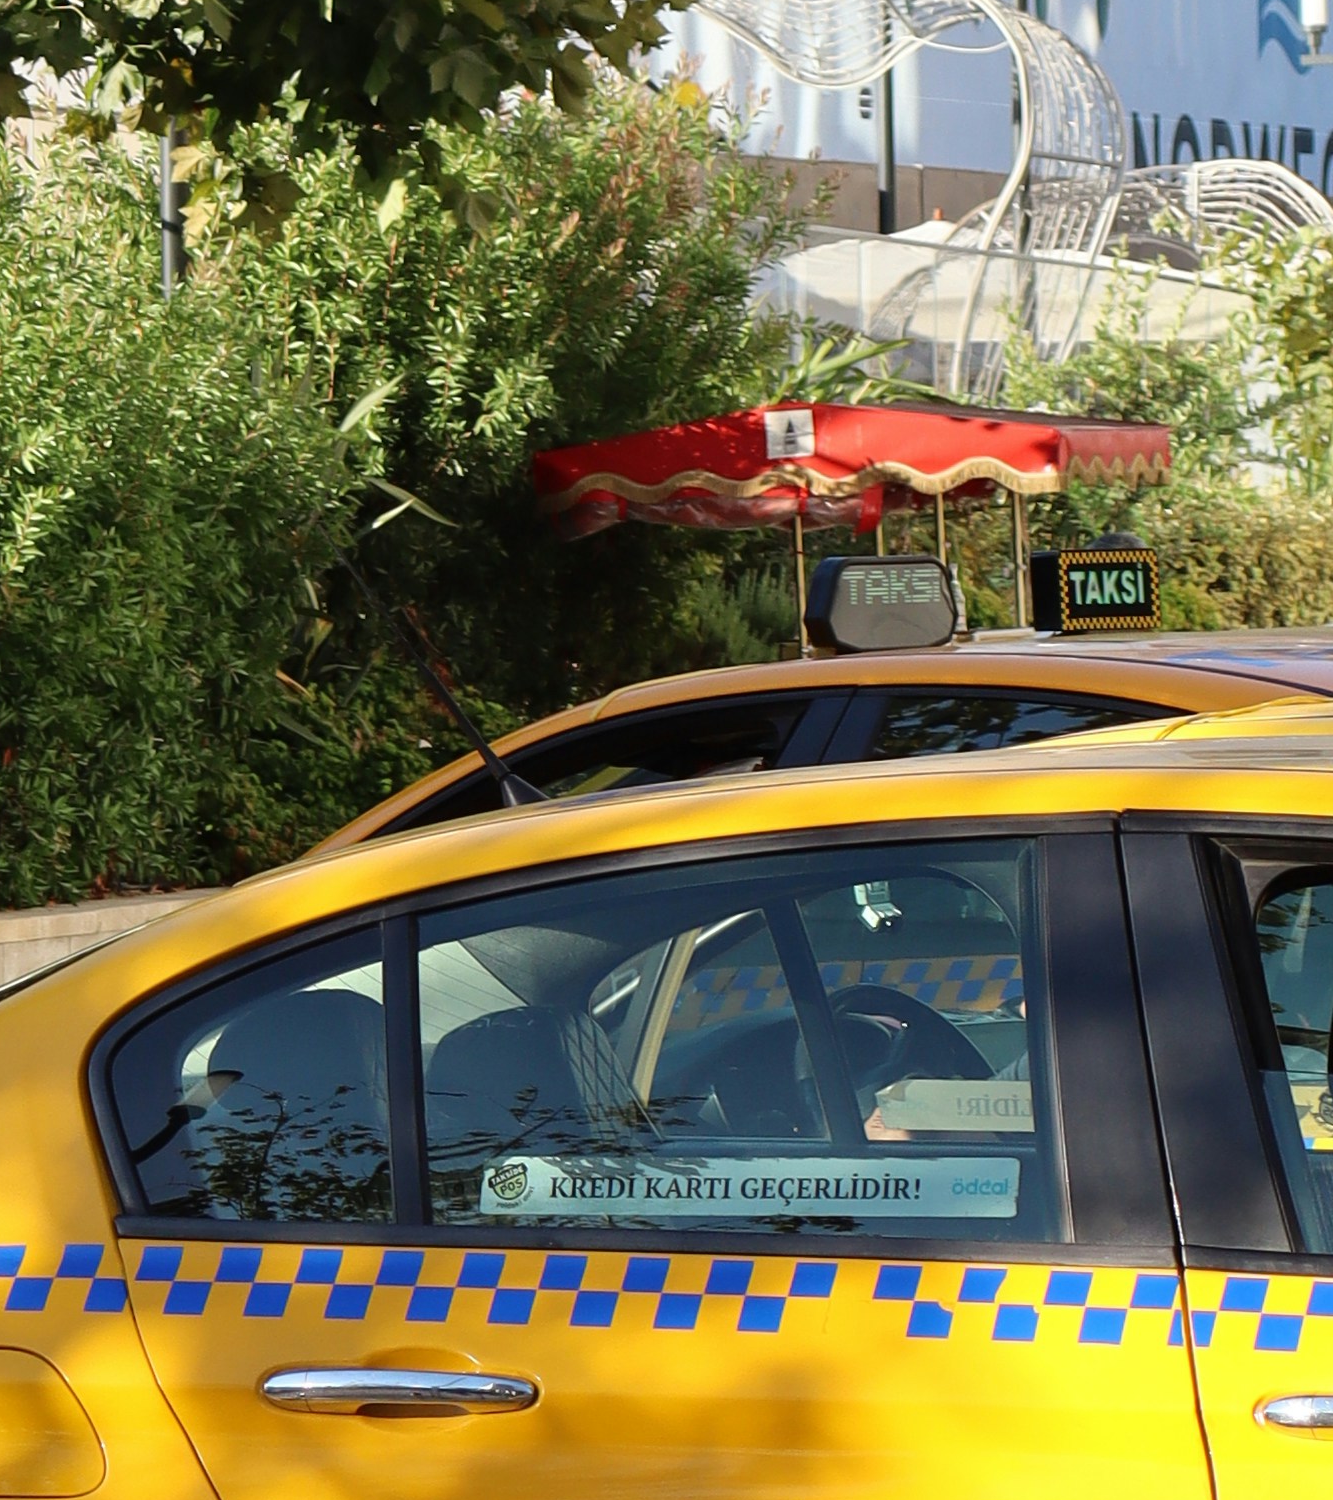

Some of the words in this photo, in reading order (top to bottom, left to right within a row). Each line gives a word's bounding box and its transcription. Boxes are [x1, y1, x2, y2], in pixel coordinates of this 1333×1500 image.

[1070, 561, 1147, 607] TAKSİ
[499, 1177, 524, 1197] POS
[550, 1169, 637, 1201] KREDİ
[643, 1175, 731, 1201] KARTI
[742, 1171, 923, 1207] GEÇERLİDİR!
